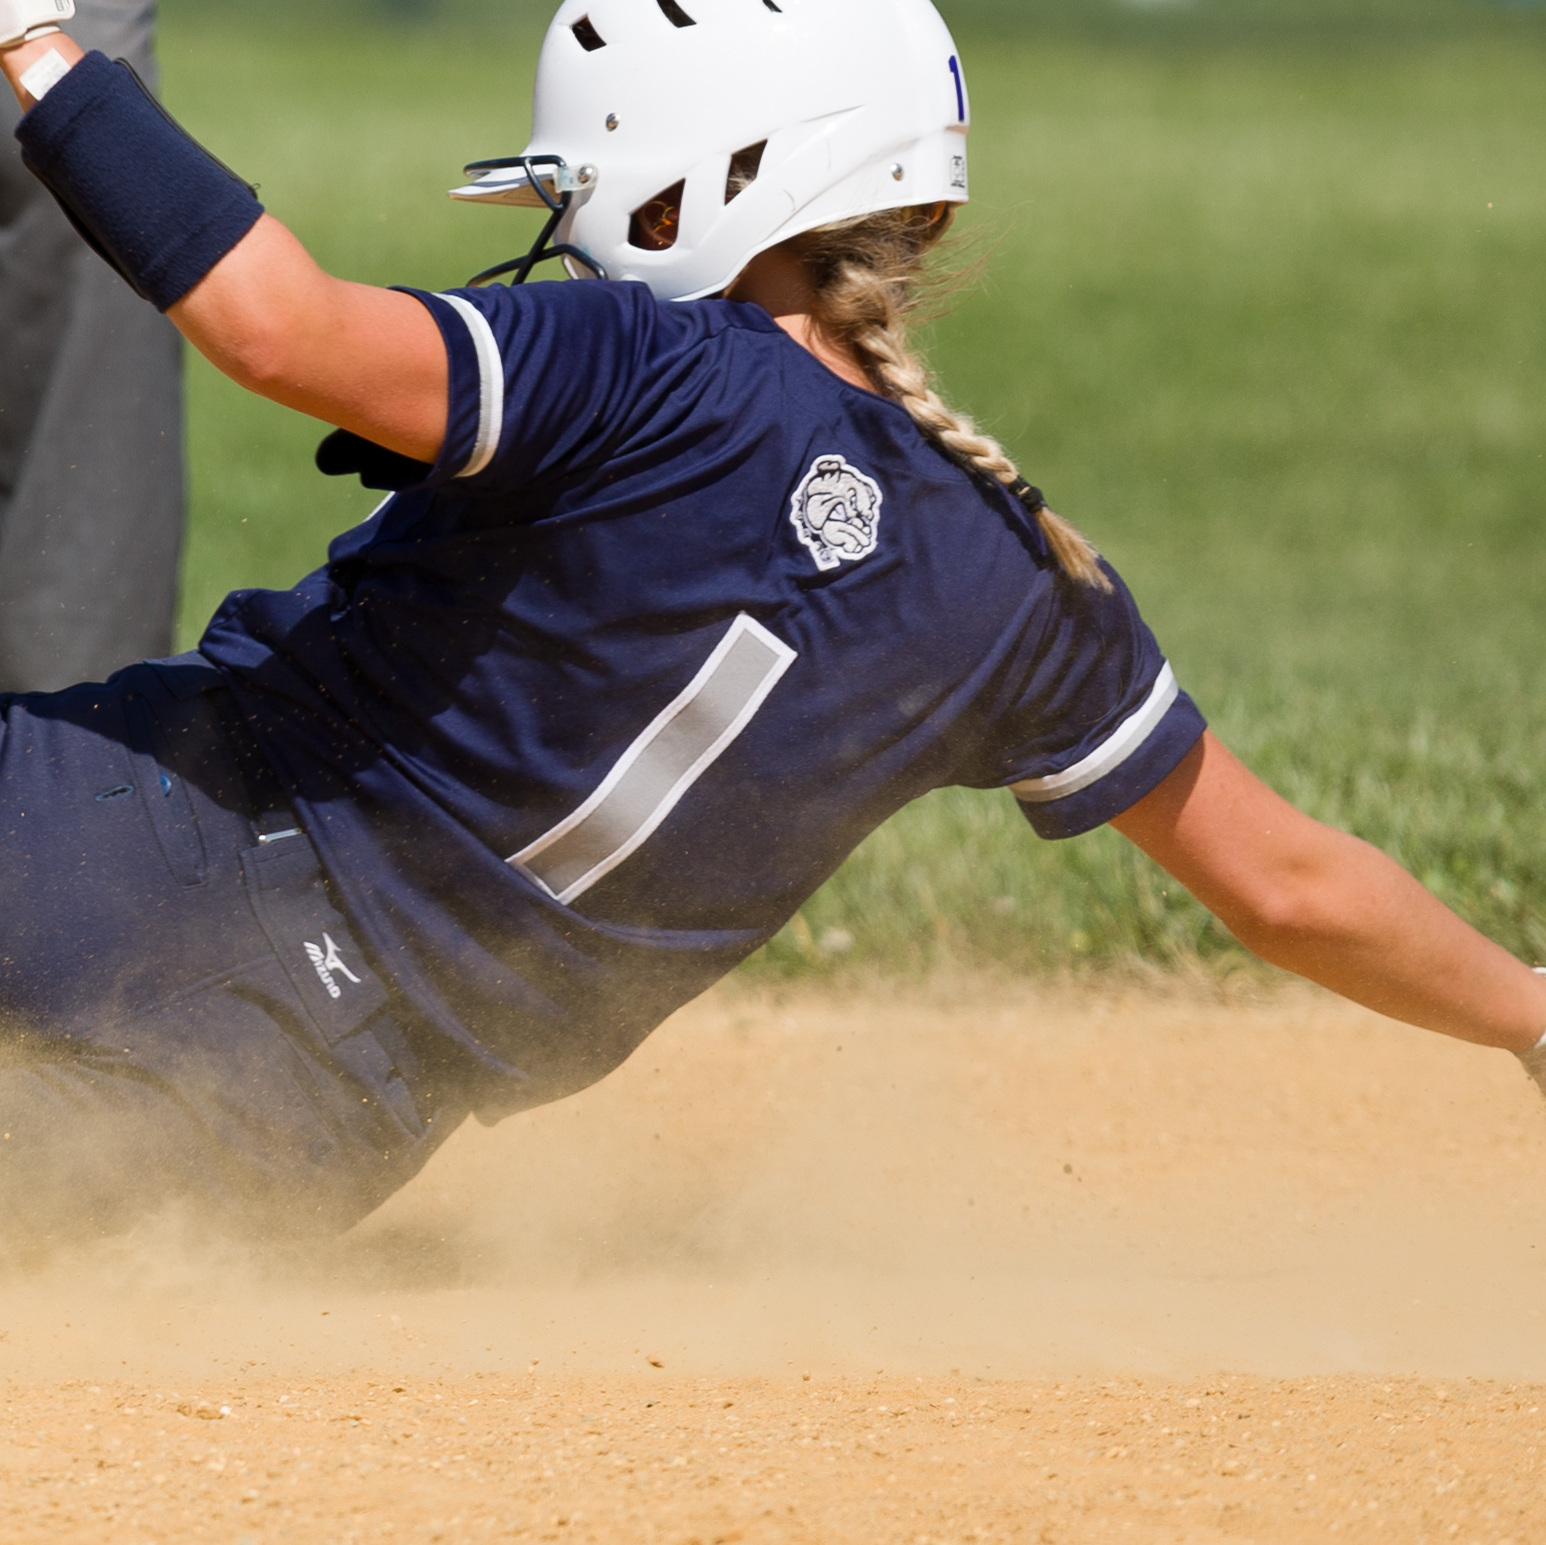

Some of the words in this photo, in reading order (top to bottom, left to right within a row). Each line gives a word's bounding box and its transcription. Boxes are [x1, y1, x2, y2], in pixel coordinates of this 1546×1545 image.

[948, 54, 965, 122] 1
[504, 611, 799, 905] 1
[303, 941, 342, 999] MIZUNO
